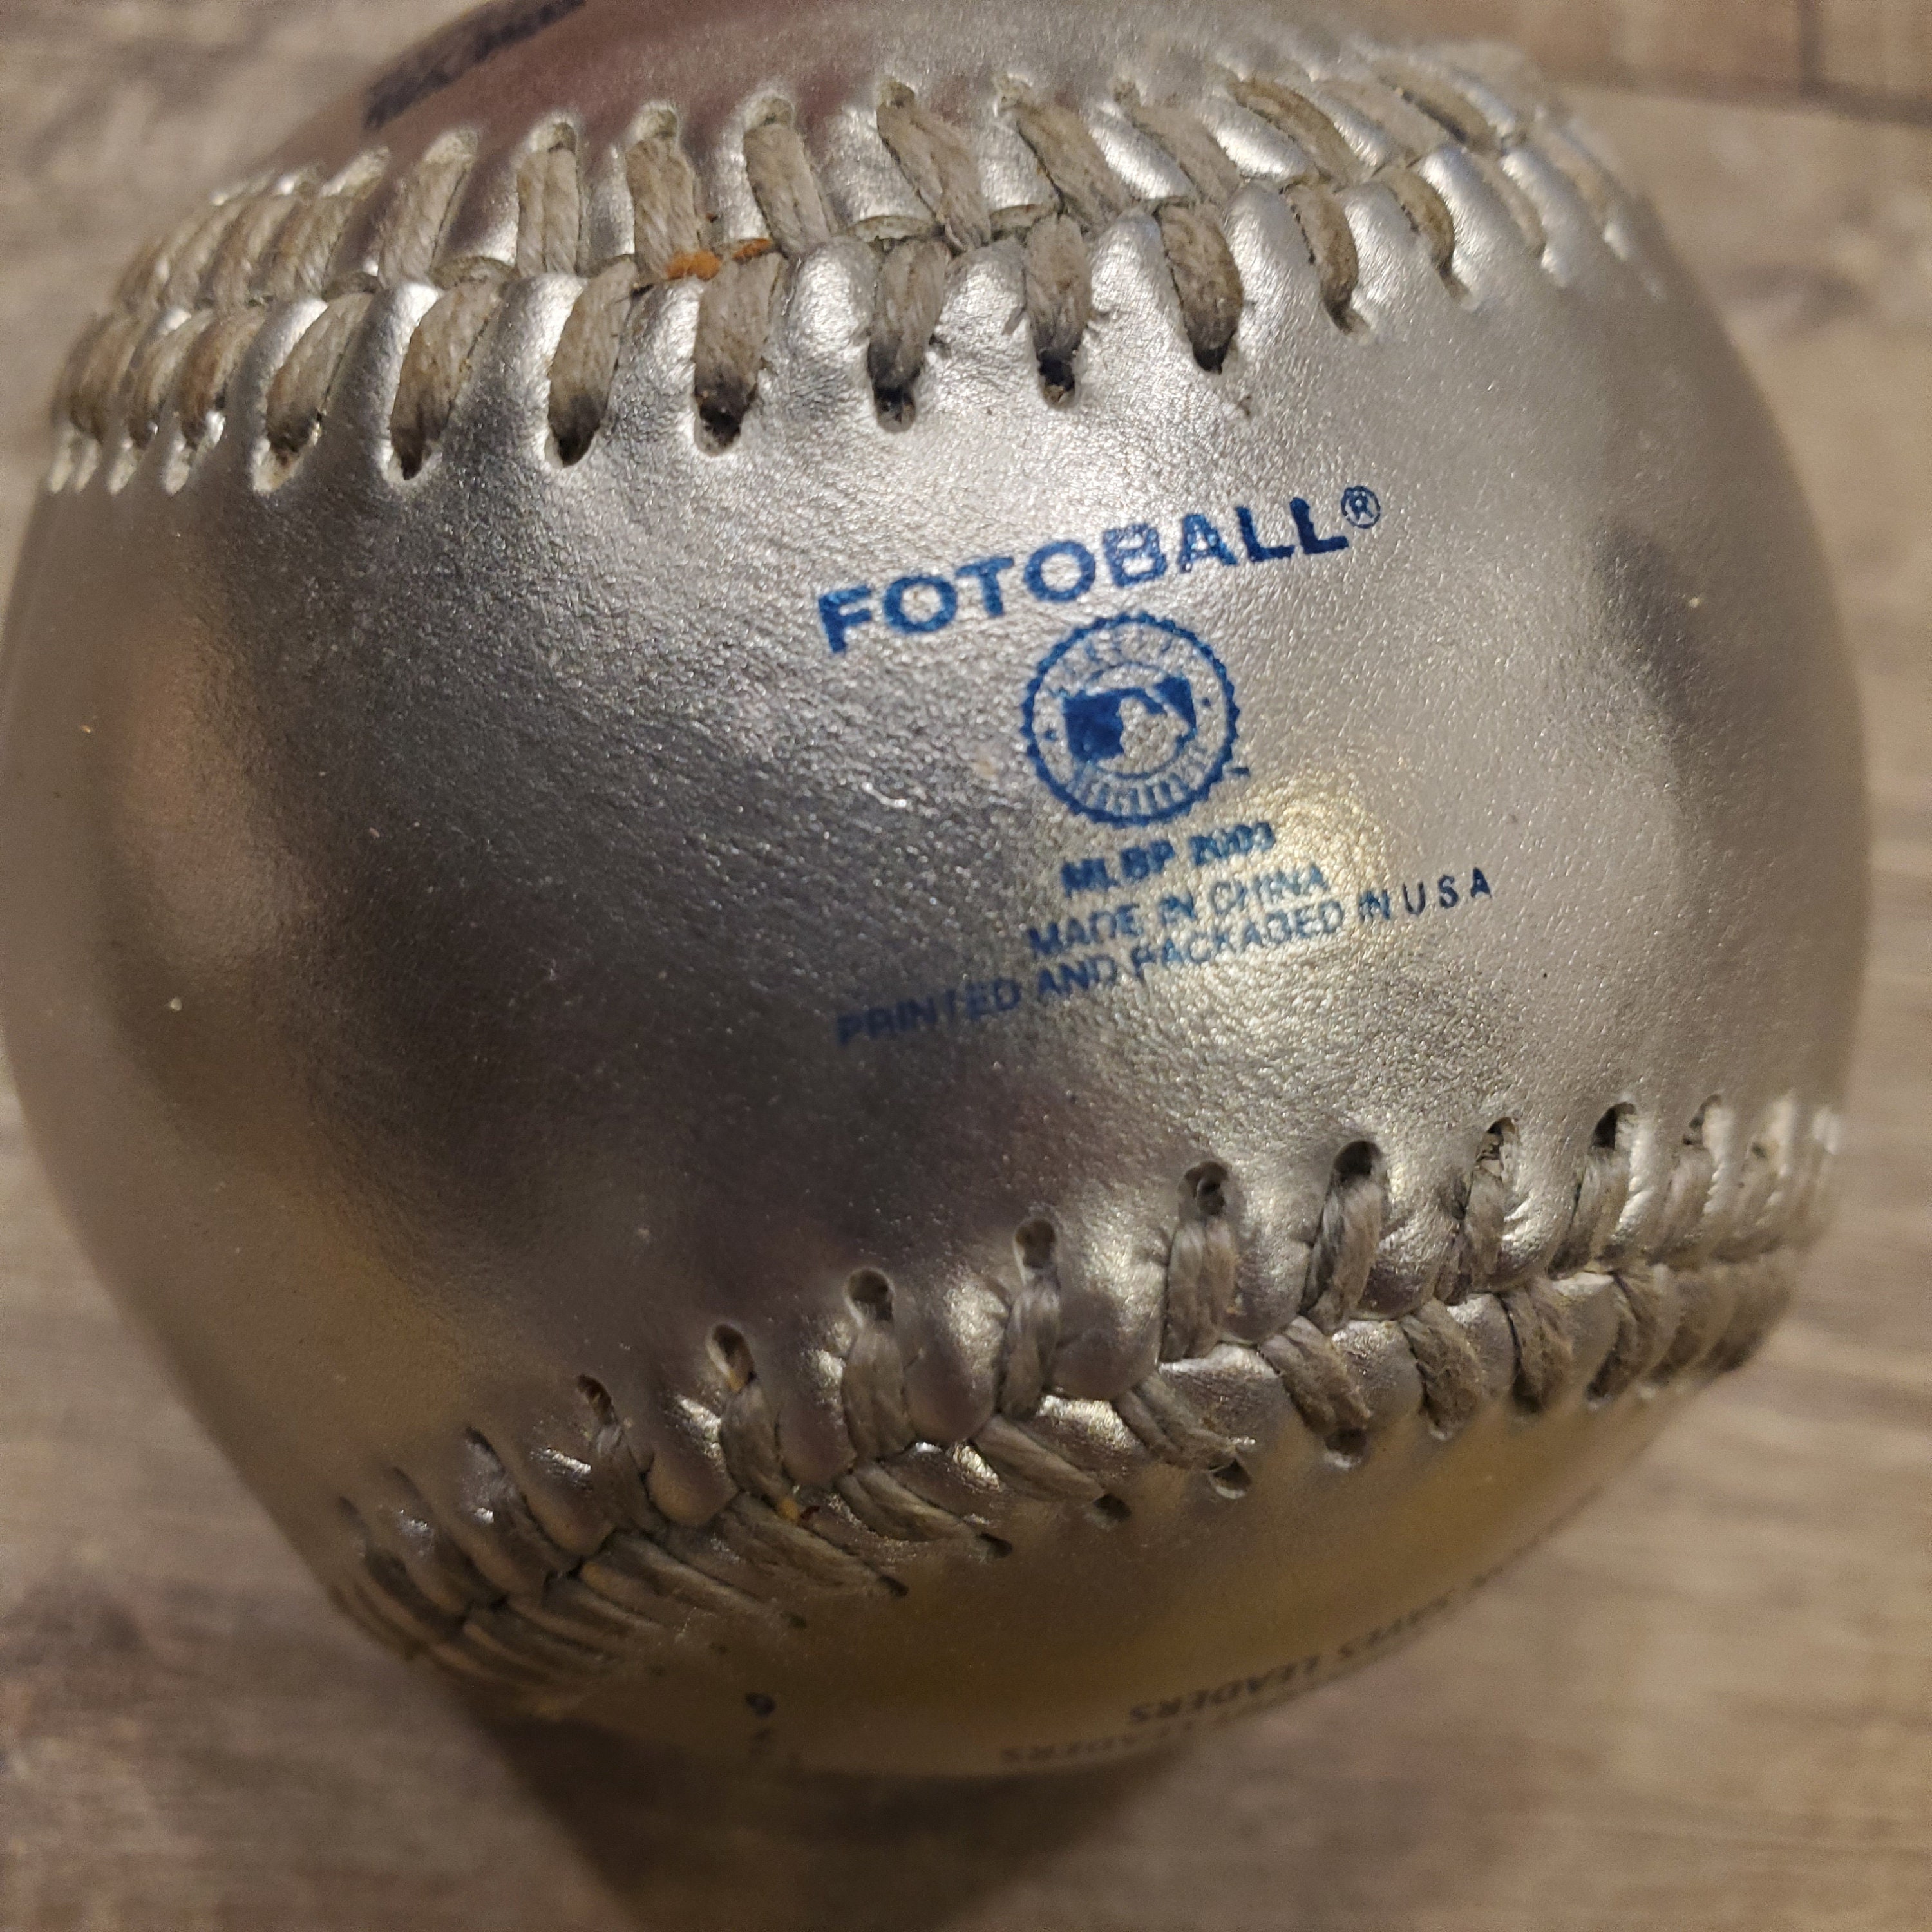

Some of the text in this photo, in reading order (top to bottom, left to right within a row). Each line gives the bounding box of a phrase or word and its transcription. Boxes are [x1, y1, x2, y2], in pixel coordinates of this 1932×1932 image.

[1026, 864, 1328, 955] MADE IN CHINA
[1060, 838, 1176, 895] MLBP
[835, 978, 1021, 1046] PRINTED
[1037, 955, 1117, 996] AND
[1130, 900, 1344, 980] PACKAGED
[1357, 889, 1393, 922] IN
